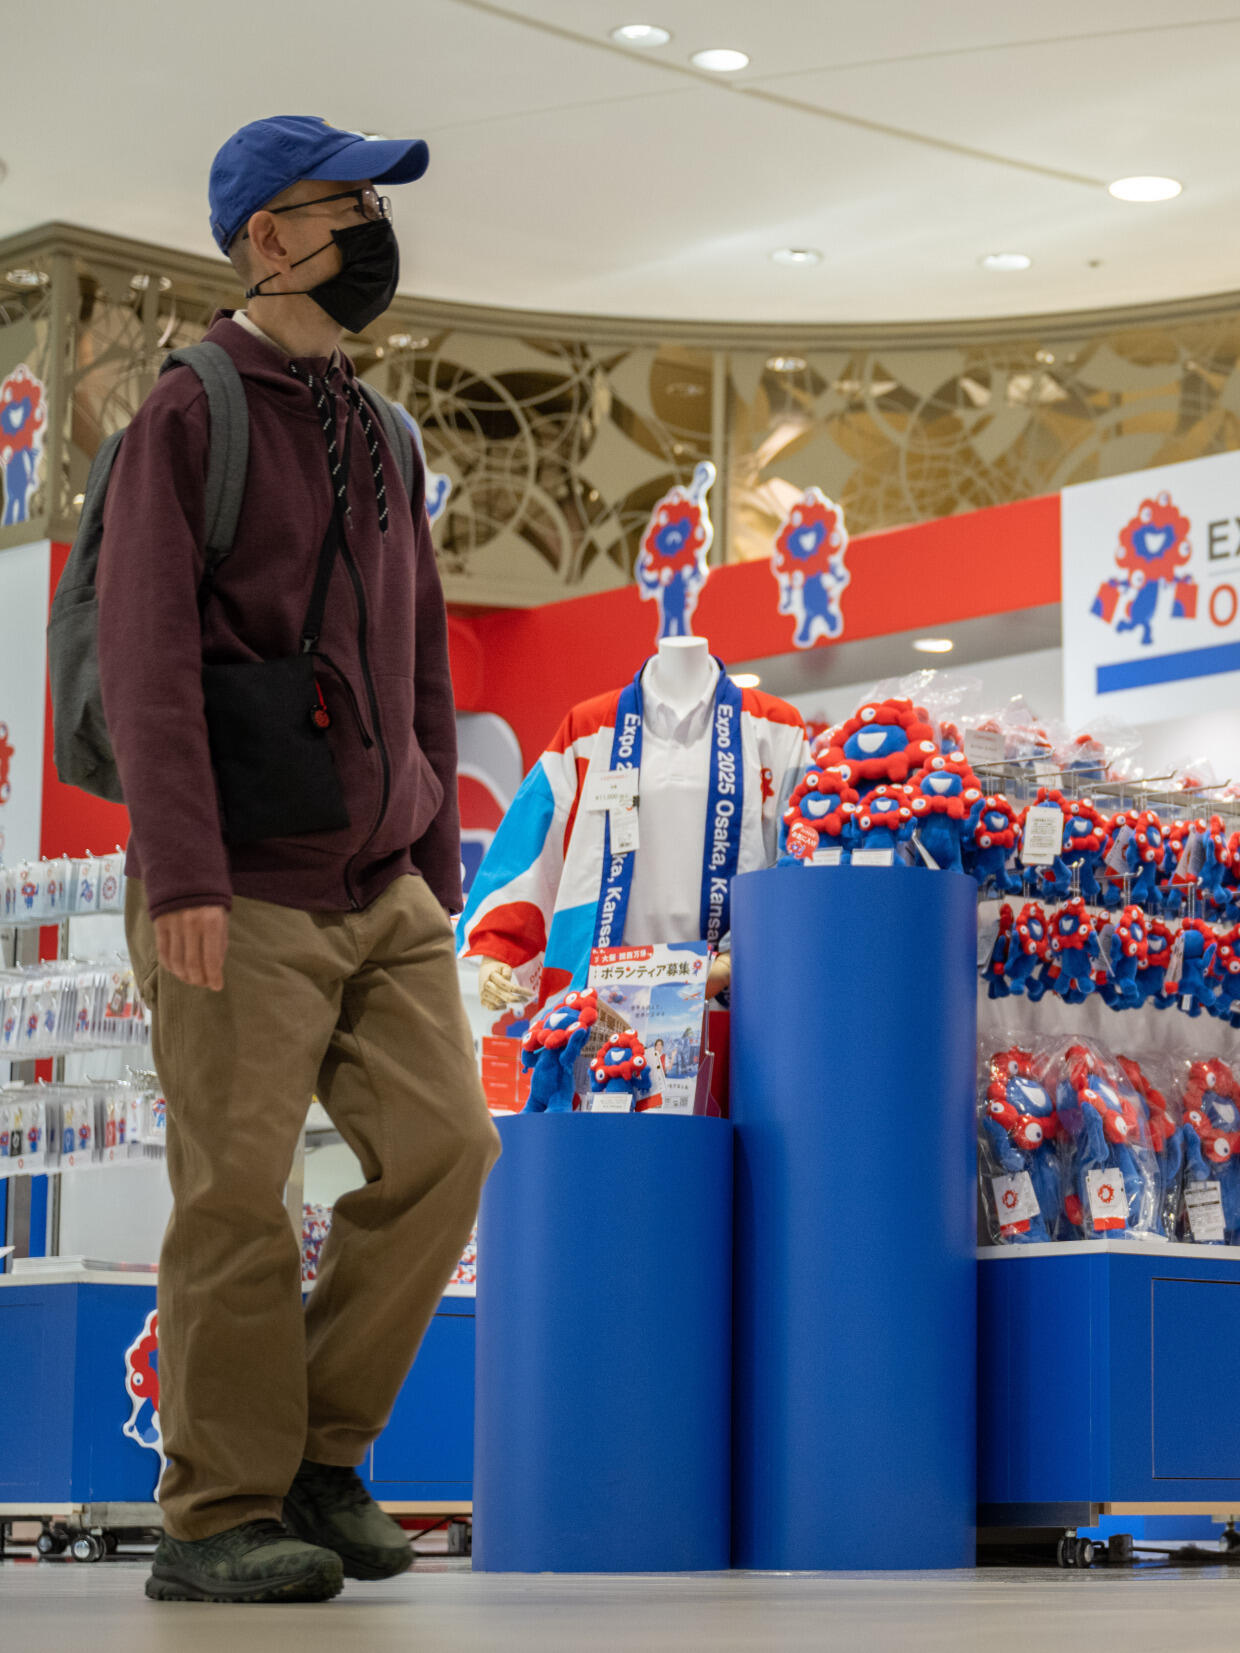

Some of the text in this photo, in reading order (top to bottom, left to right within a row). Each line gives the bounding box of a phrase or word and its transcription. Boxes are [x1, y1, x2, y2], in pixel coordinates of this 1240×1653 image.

[618, 713, 641, 758] Expo
[714, 703, 733, 748] Expo
[717, 752, 735, 795] 2025
[708, 799, 735, 871] Osaka,
[598, 887, 623, 948] Kansa
[601, 961, 690, 980] ボランティア募集
